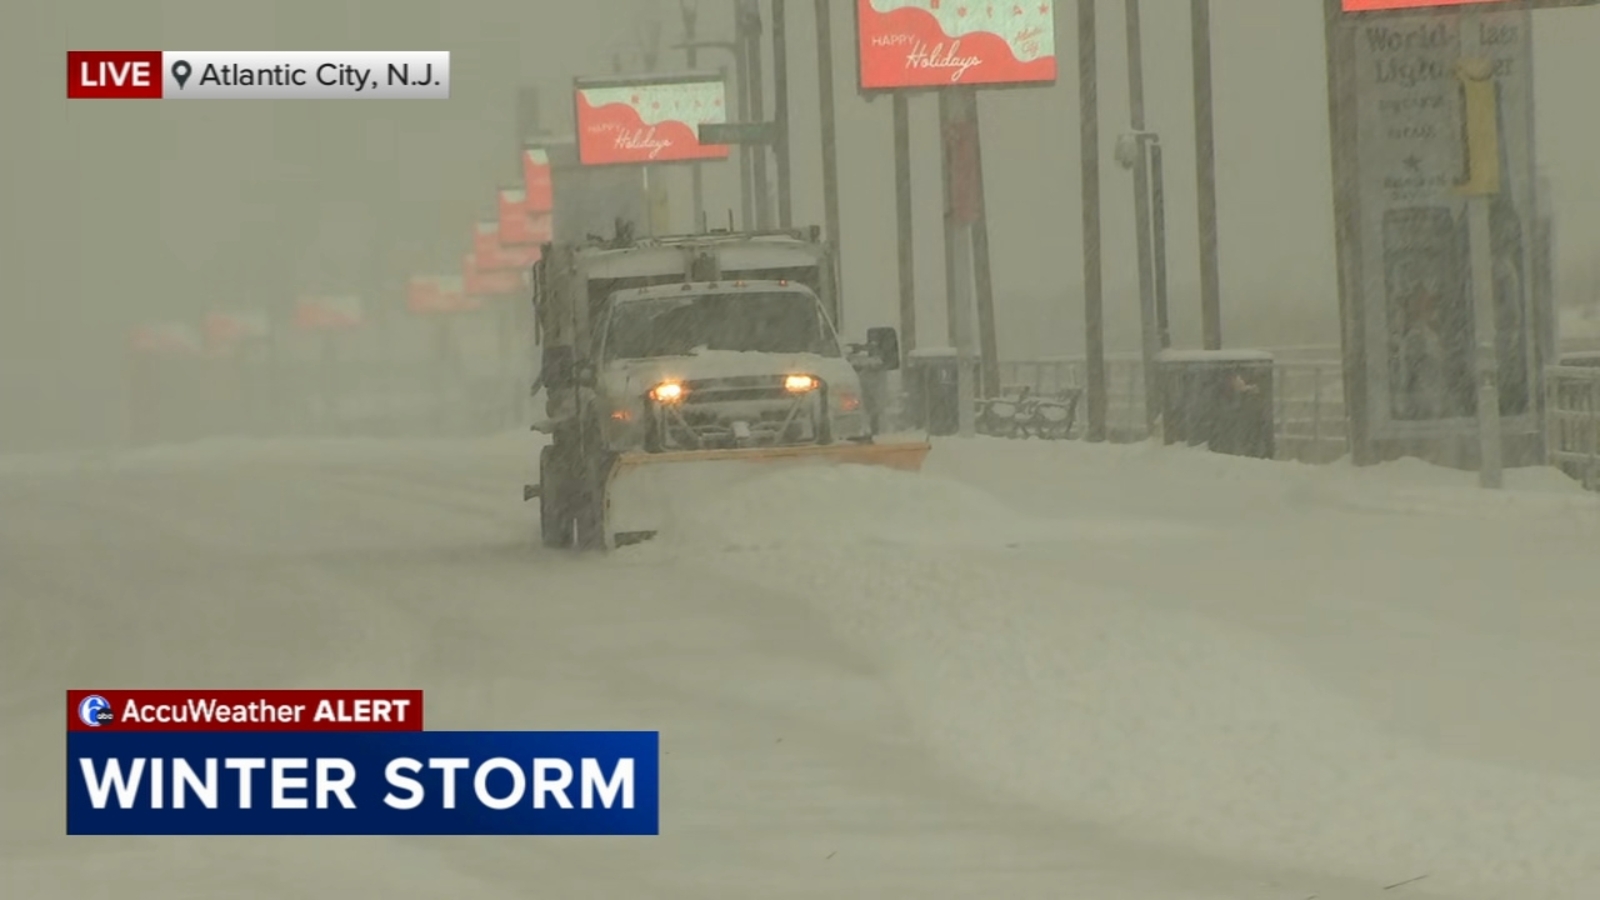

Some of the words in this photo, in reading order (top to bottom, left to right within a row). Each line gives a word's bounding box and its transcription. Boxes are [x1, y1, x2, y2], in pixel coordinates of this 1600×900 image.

[872, 33, 915, 46] HAPPY
[905, 39, 983, 82] Holidays
[614, 126, 674, 160] Holidays
